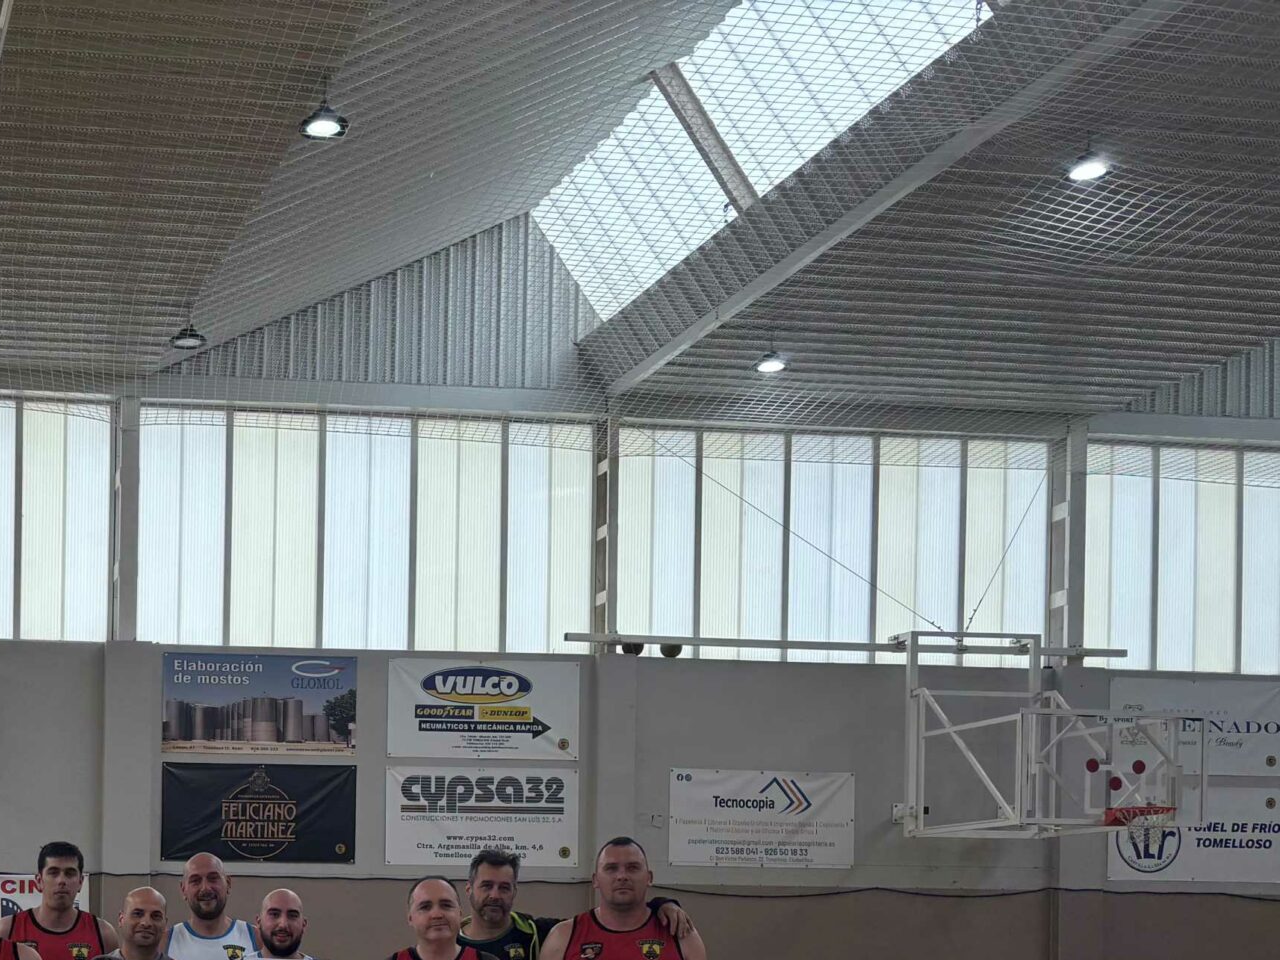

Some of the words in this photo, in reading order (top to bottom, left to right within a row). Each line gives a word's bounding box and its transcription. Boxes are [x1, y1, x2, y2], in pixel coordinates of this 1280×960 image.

[174, 660, 263, 672] Elaboración
[174, 673, 191, 684] de
[197, 675, 249, 685] mostos
[291, 677, 343, 690] GLOMOL
[435, 675, 520, 696] VULCO
[489, 709, 528, 717] DUNLOP
[421, 722, 469, 730] NEUMÁTICOS
[477, 722, 514, 731] MECÁNICA
[516, 723, 542, 731] RÁPIDA
[713, 795, 775, 811] Tecnocopia
[222, 803, 296, 820] FELICIANO
[401, 814, 458, 822] CONSTRUCCIONES
[1231, 823, 1249, 833] DE
[1196, 838, 1273, 849] TOMELLOSO
[715, 847, 730, 855] 623
[746, 847, 758, 855] 041
[799, 848, 808, 856] 33
